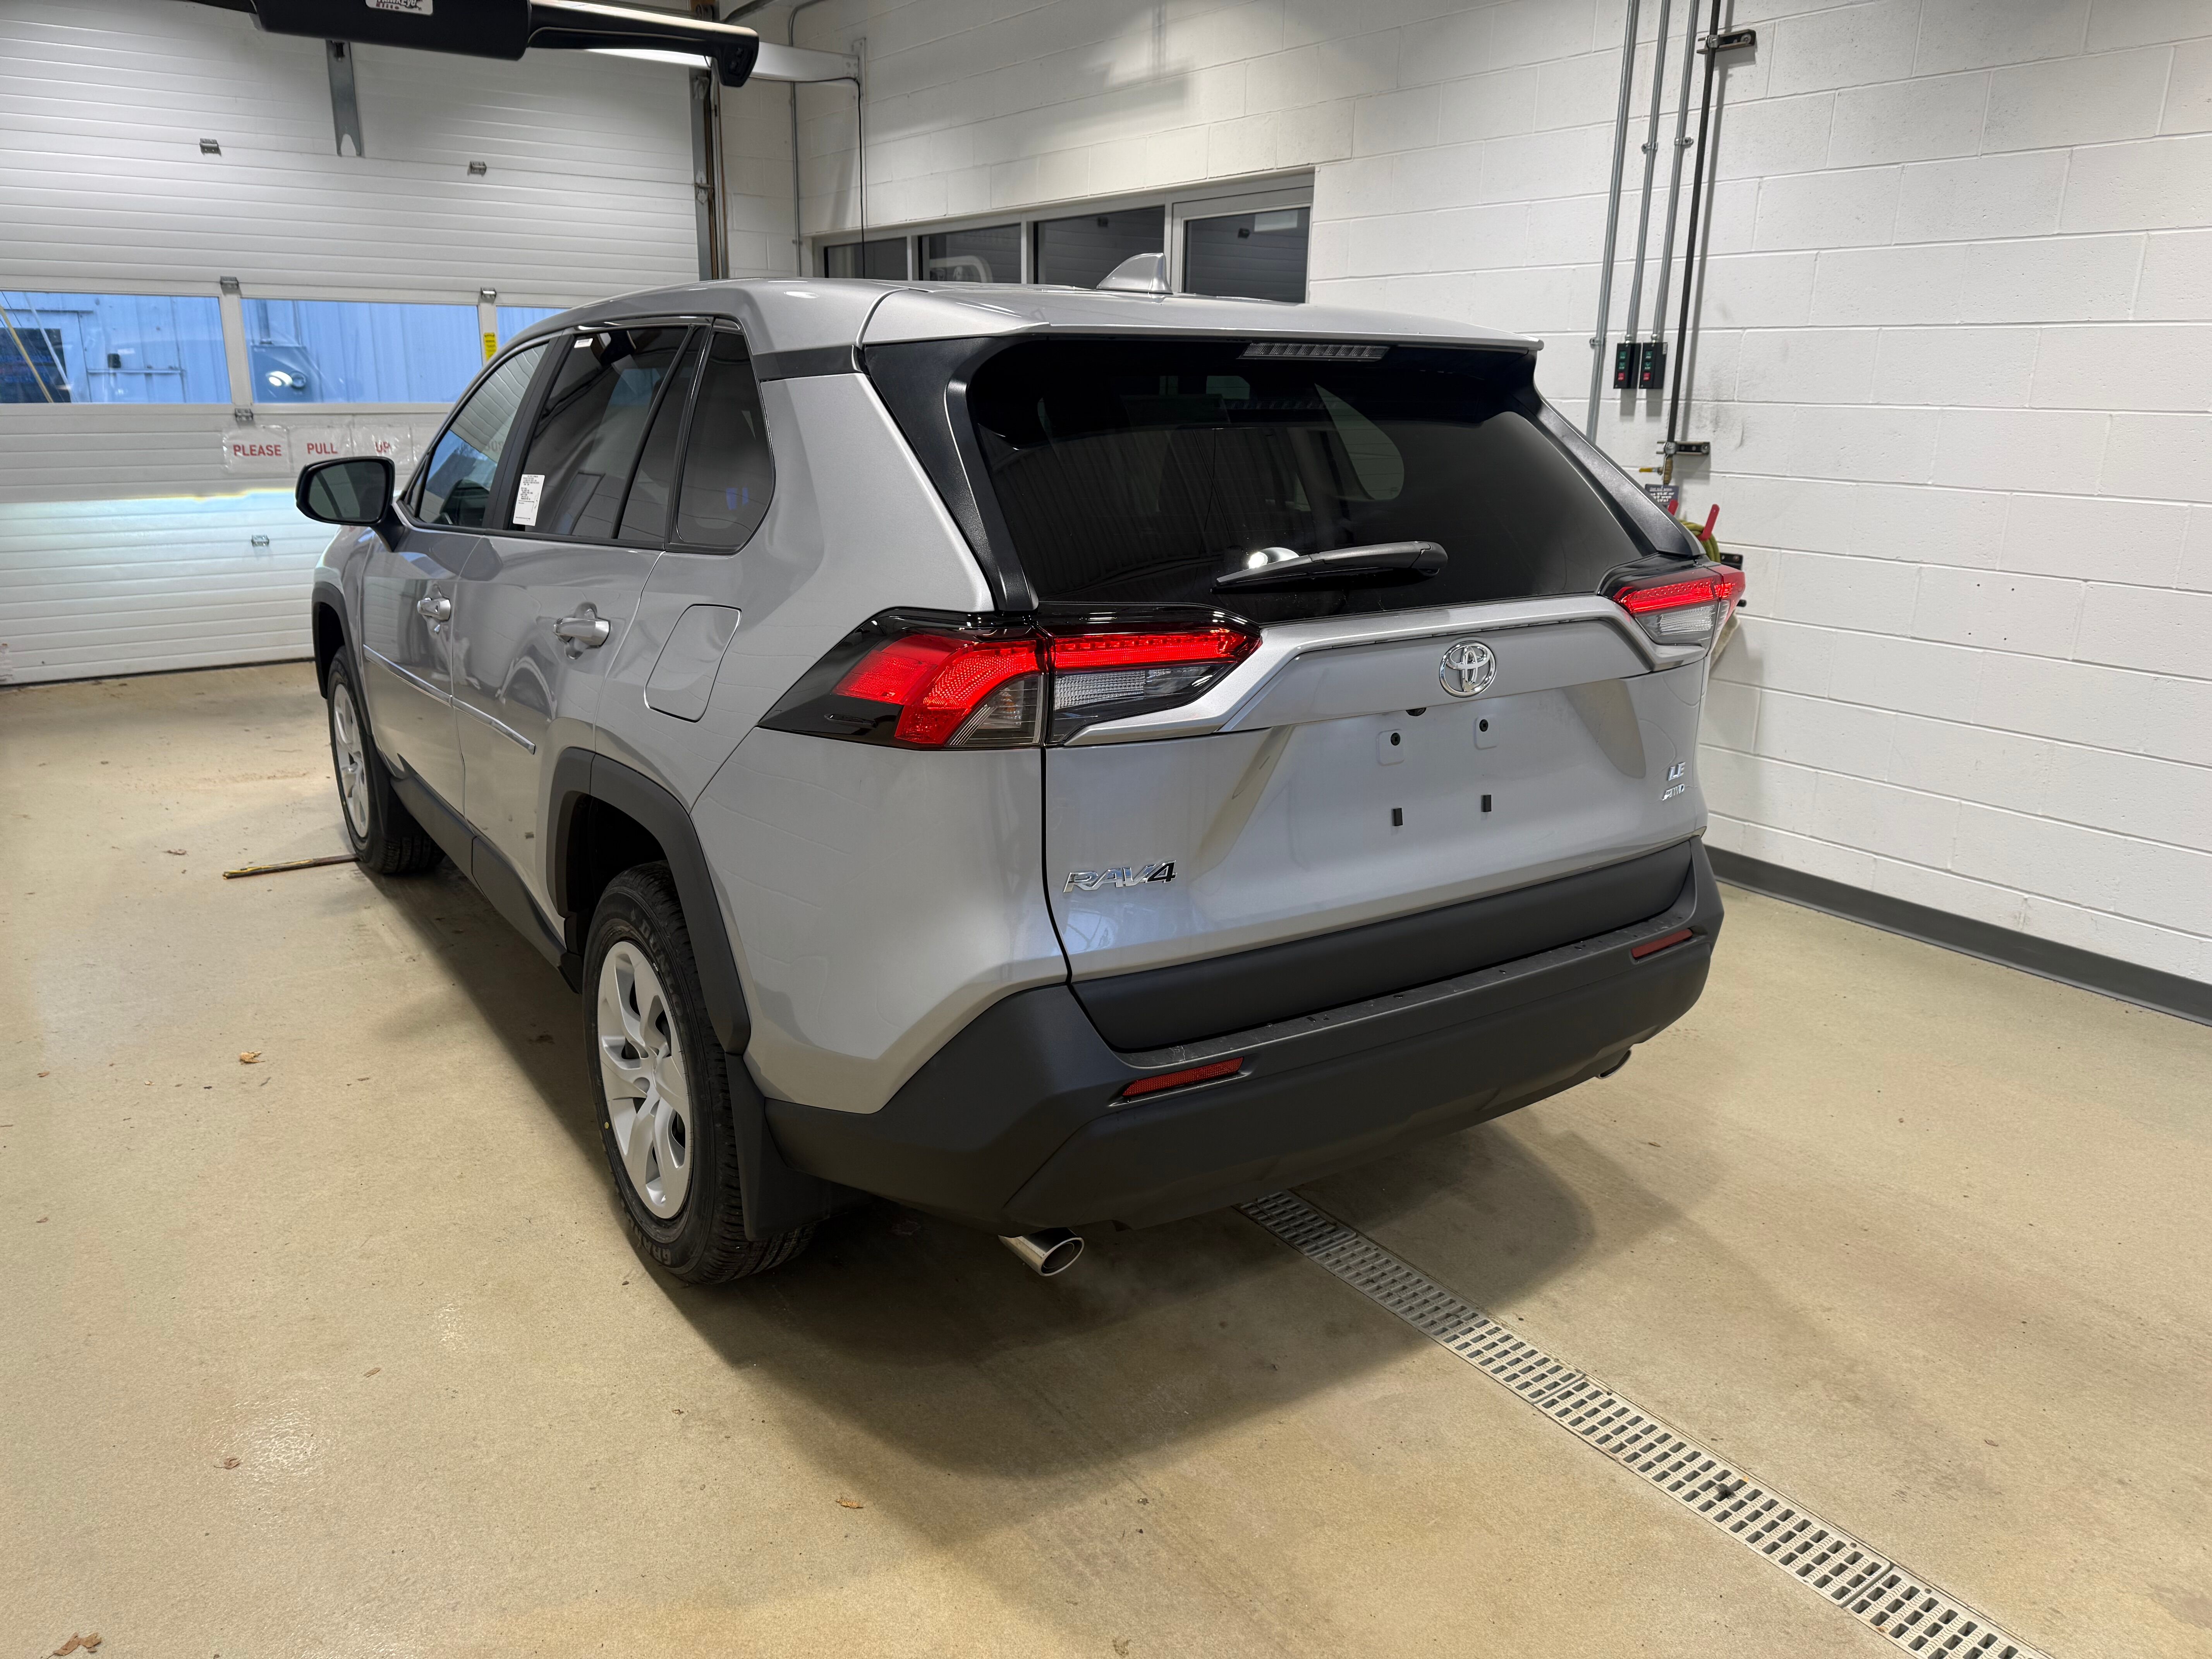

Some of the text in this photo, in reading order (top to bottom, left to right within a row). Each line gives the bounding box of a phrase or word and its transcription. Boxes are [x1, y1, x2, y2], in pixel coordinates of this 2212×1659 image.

[233, 441, 391, 457] PLEASE PULL UP
[1667, 762, 1686, 781] LE
[1063, 860, 1178, 893] RAV4
